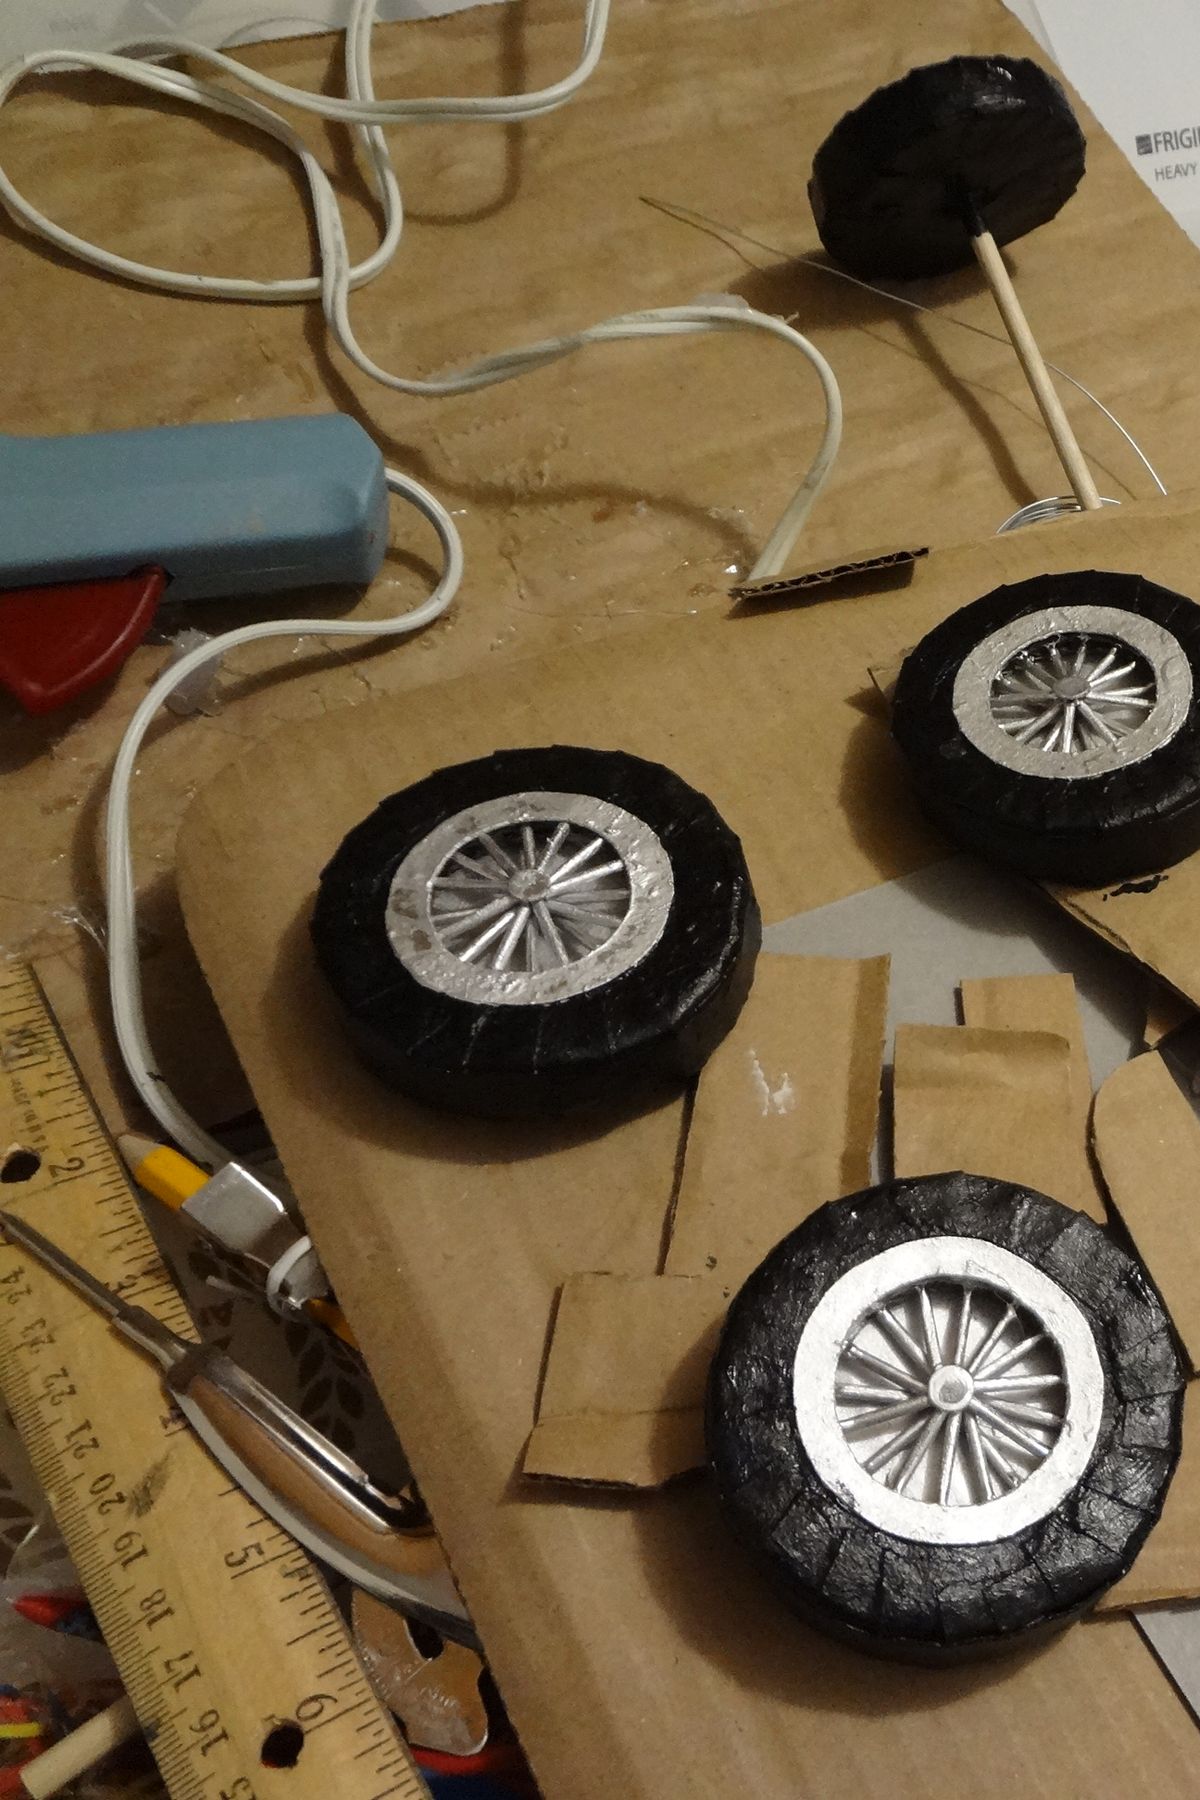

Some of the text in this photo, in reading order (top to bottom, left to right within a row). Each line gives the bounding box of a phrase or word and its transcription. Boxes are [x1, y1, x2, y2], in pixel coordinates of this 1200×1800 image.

[1154, 161, 1198, 182] HEAVY
[48, 1156, 85, 1179] 2
[19, 1317, 56, 1354] 23
[43, 1366, 77, 1407] 22
[64, 1418, 100, 1460] 21
[89, 1472, 126, 1516] 20
[113, 1530, 148, 1570] 19
[224, 1541, 265, 1568] 5
[139, 1588, 175, 1631] 18
[164, 1650, 201, 1692] 17
[295, 1693, 338, 1722] 6
[189, 1708, 229, 1757] 16
[219, 1776, 257, 1800] 5
